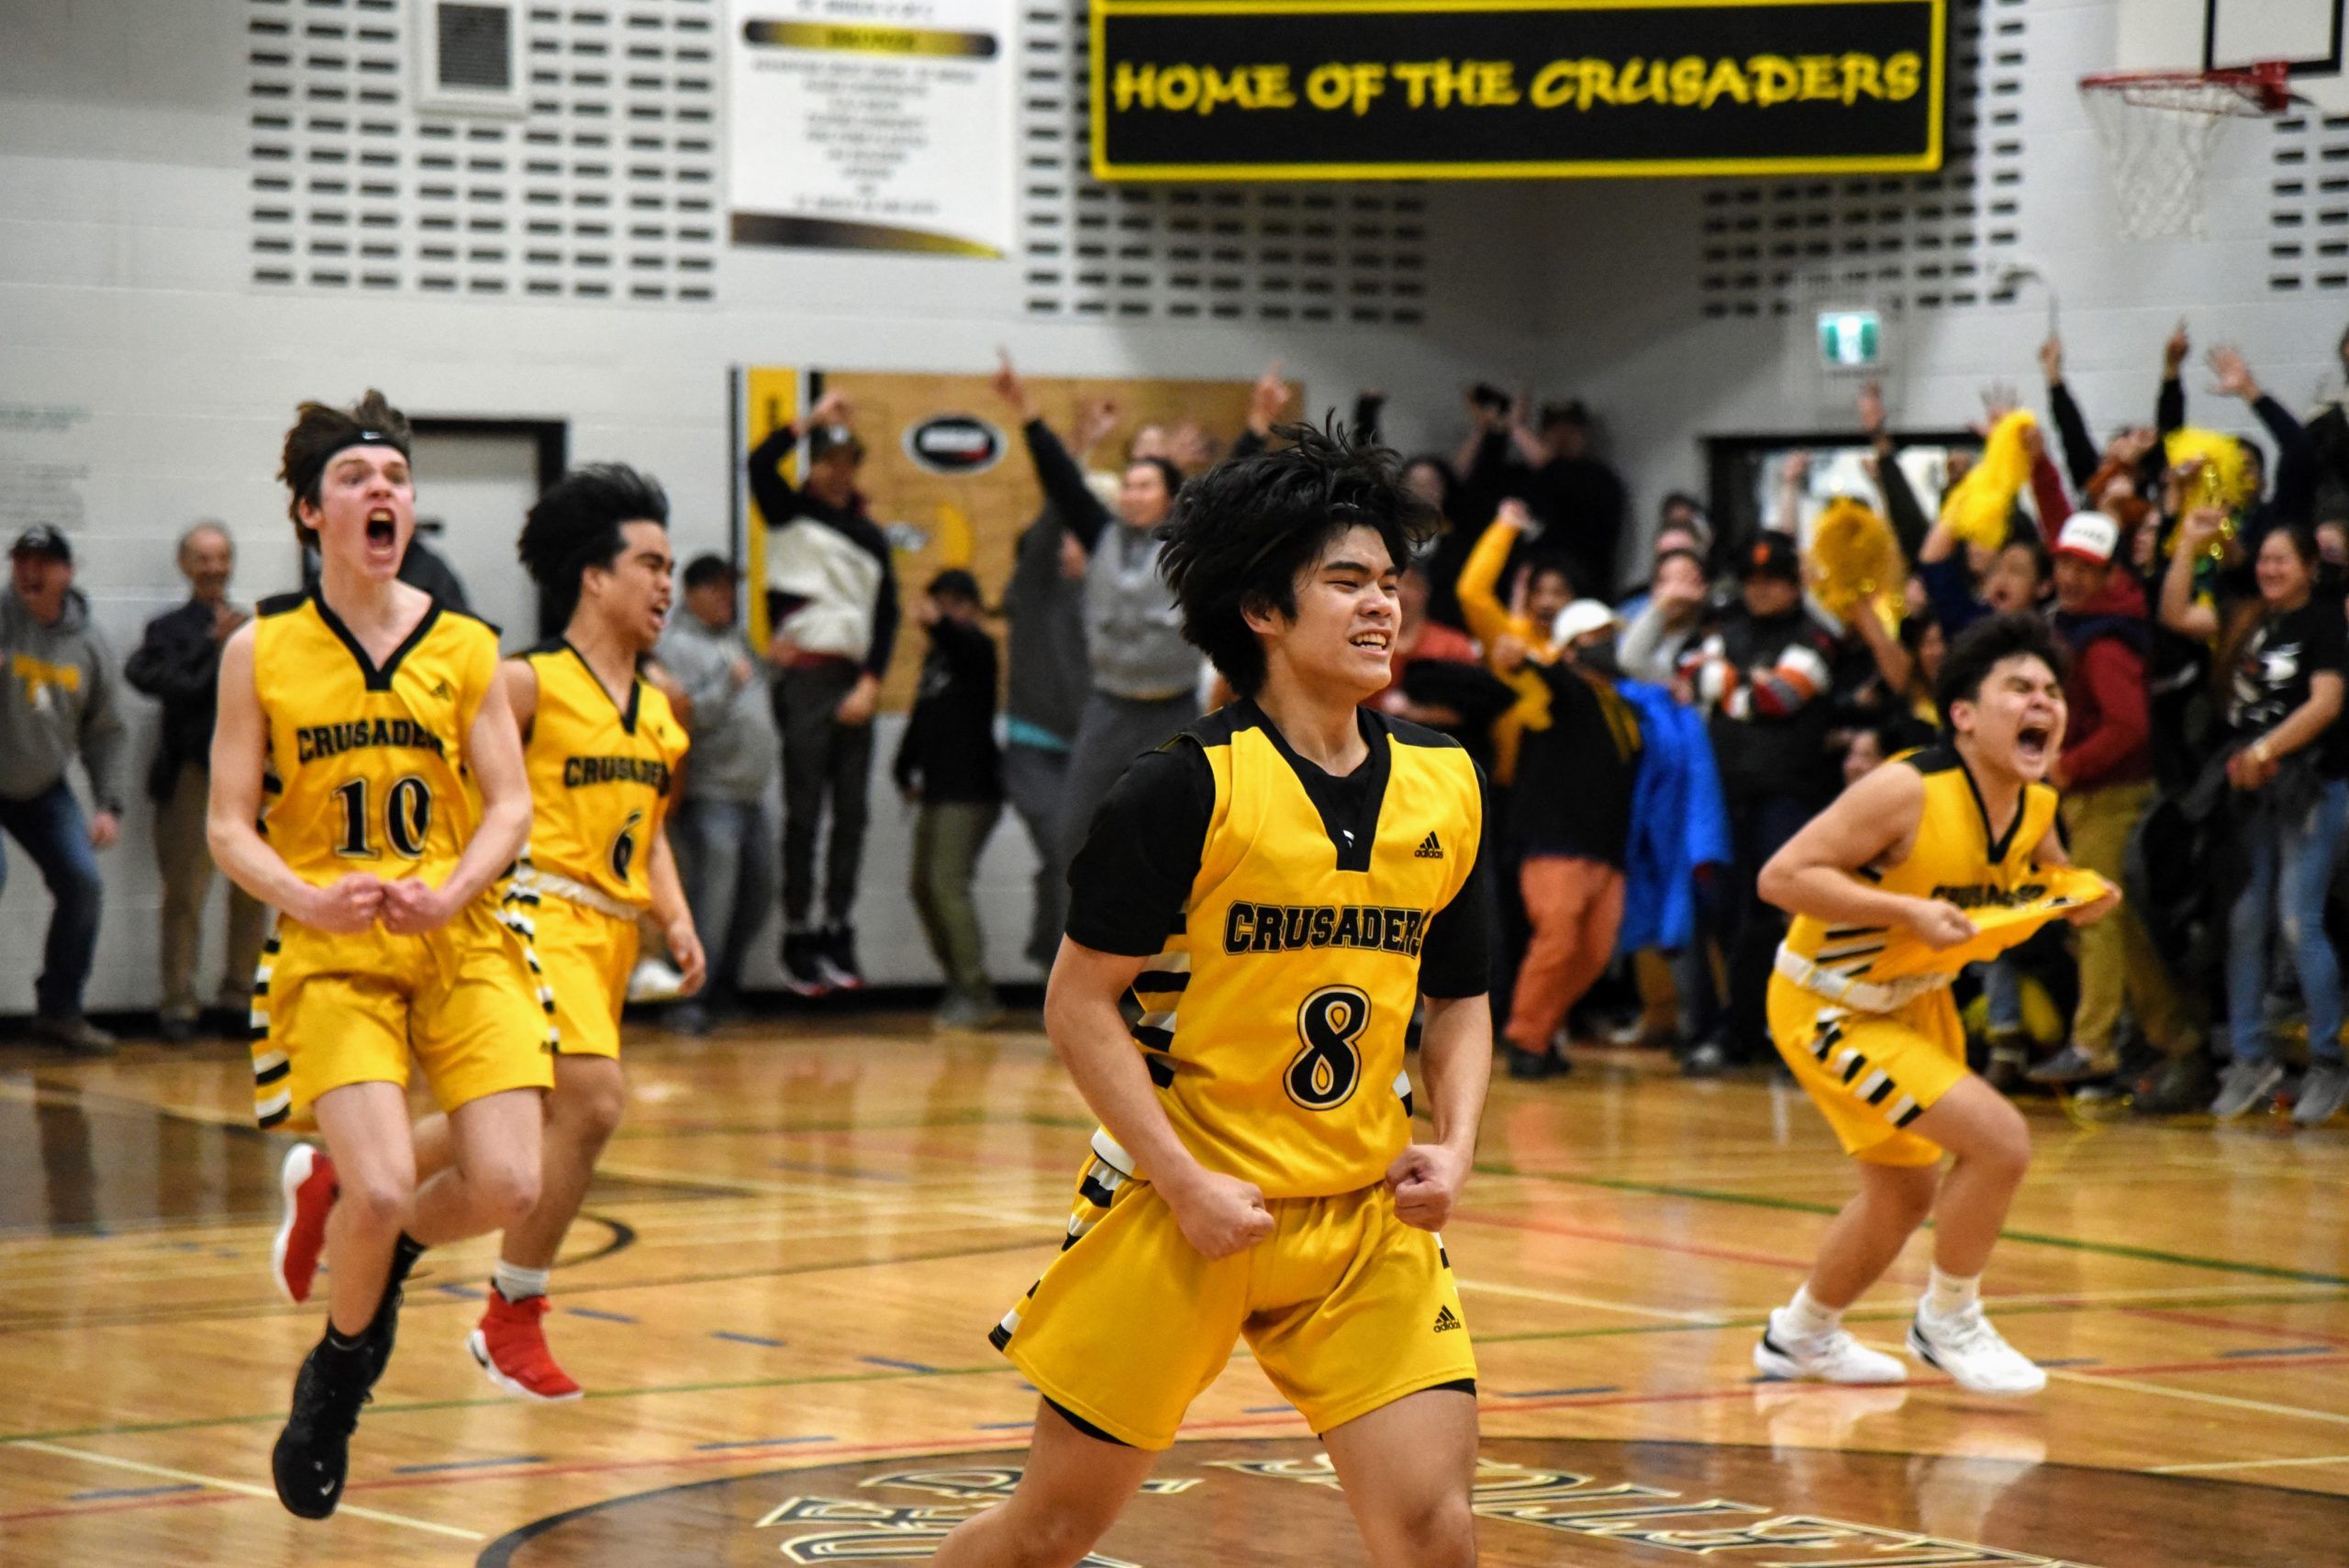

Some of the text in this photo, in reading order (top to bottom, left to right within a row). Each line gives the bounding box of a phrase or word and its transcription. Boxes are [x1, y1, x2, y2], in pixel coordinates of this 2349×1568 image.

[1113, 50, 1921, 117] HOME OF THE CRUSADERS
[331, 774, 433, 862] 10
[612, 808, 642, 886] 6
[1414, 848, 1443, 860] adidas
[1283, 984, 1372, 1111] 8
